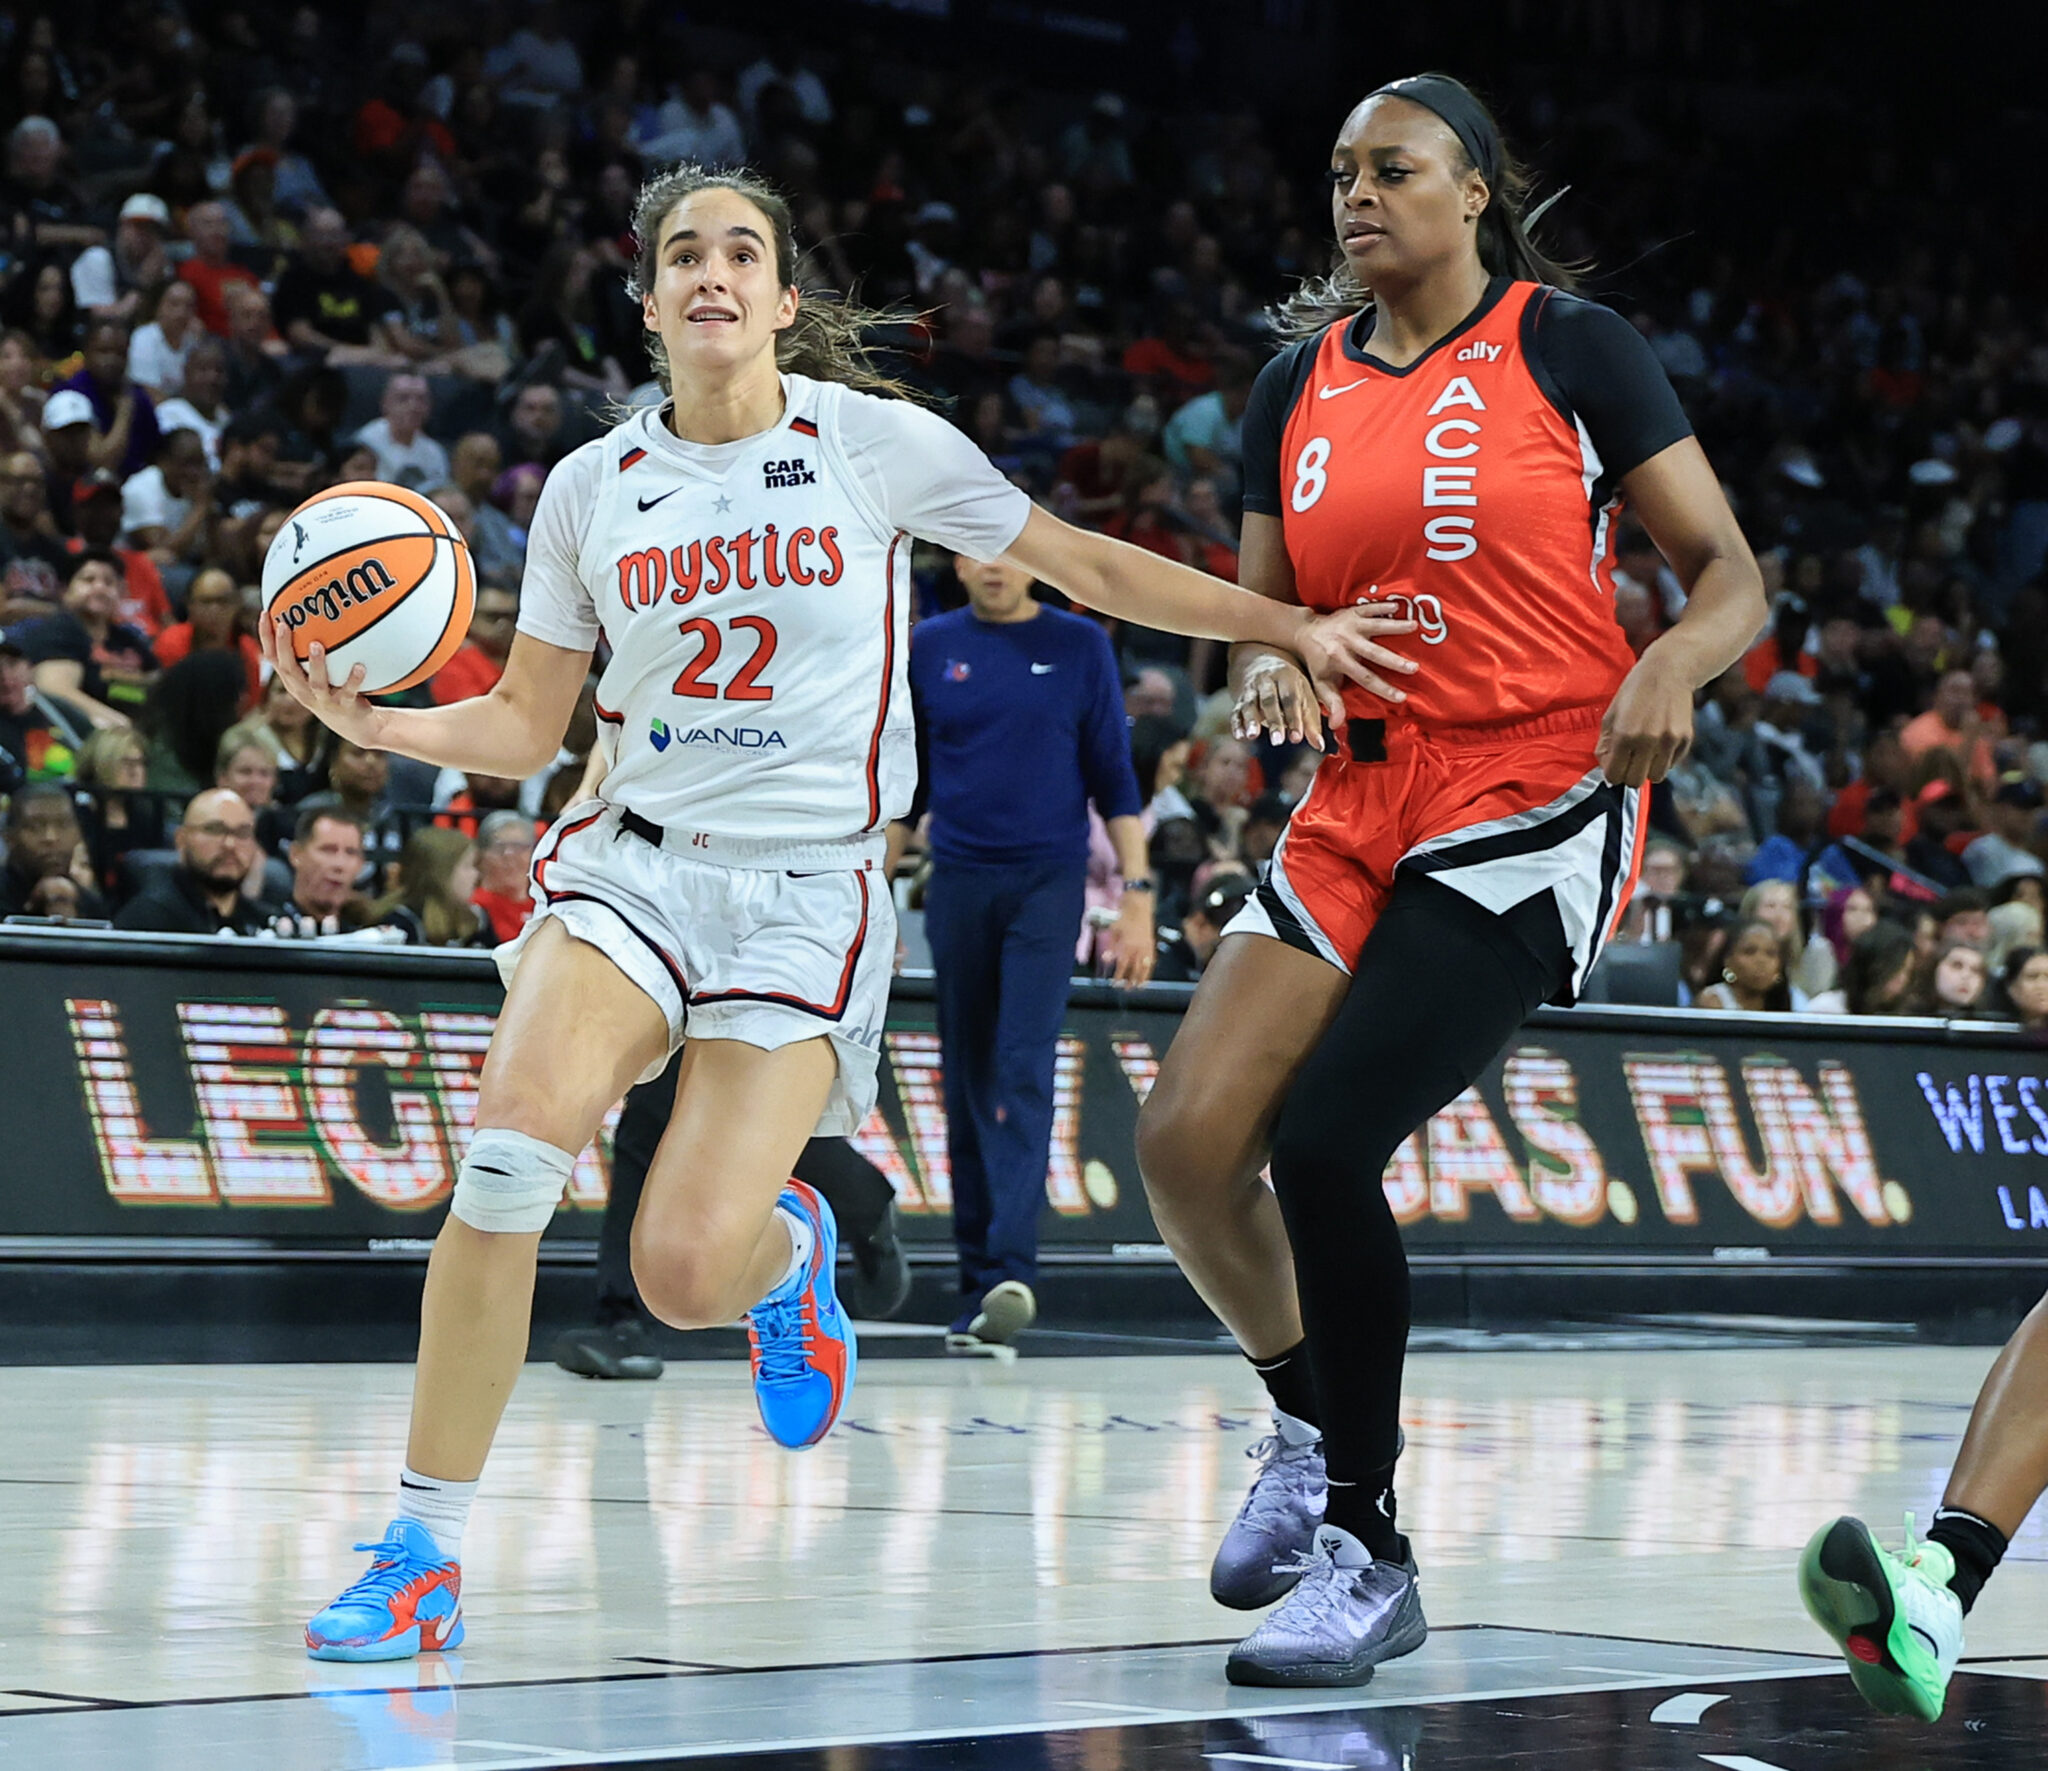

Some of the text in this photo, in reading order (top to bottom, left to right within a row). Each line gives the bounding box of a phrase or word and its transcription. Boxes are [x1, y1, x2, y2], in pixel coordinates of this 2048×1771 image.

[1457, 341, 1502, 362] ally
[763, 458, 806, 474] CAR
[765, 471, 817, 489] max
[1291, 436, 1332, 513] 8
[1422, 375, 1487, 562] ACES
[672, 615, 778, 701] 22
[675, 727, 787, 749] VANDA
[1621, 1052, 1913, 1228] FUN.
[1916, 1071, 2048, 1156] WES
